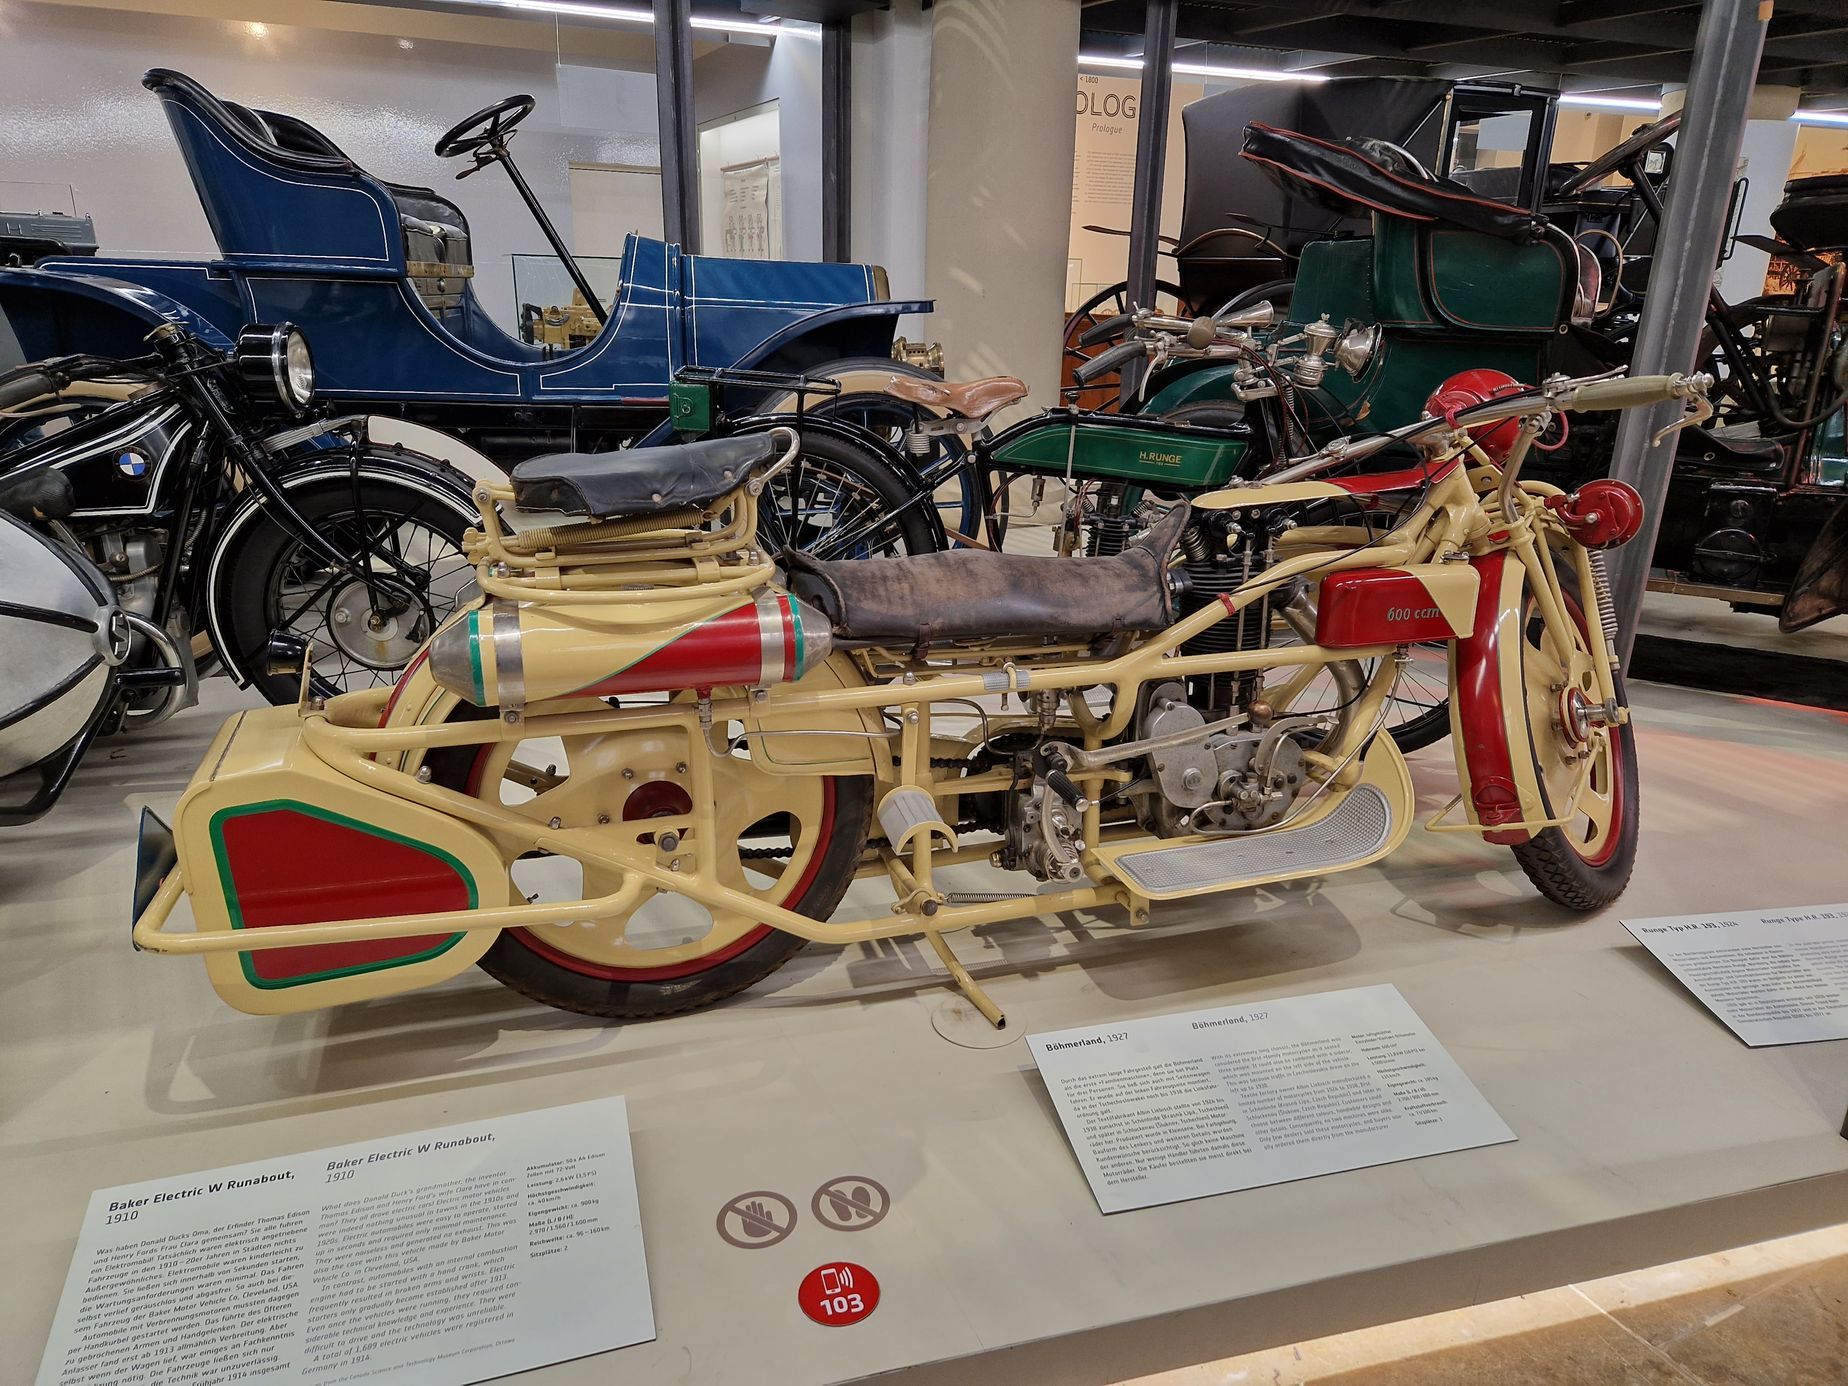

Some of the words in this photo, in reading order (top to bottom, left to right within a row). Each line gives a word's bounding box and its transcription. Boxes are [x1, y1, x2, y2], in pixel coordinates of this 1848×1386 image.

[1092, 122, 1122, 135] Prologue
[1388, 607, 1410, 621] 600
[1414, 608, 1440, 618] ccm
[1191, 1015, 1247, 1029] Böhmerland,
[1249, 1012, 1267, 1021] 1927
[1045, 1036, 1105, 1051] Böhmerland,
[1107, 1032, 1127, 1041] 1927
[326, 1158, 363, 1170] Baker
[367, 1147, 412, 1162] Electric
[417, 1143, 430, 1153] W
[434, 1133, 494, 1150] Runabout,
[108, 1198, 149, 1211] Baker
[153, 1187, 202, 1203] Electric
[208, 1182, 222, 1192] W
[226, 1170, 294, 1189] Runabout,
[326, 1169, 354, 1183] 1910
[105, 1210, 138, 1224] 1910
[115, 1243, 138, 1251] haben
[140, 1236, 166, 1246] Donald
[167, 1233, 189, 1241] Ducks
[226, 1220, 254, 1230] Erfinder
[257, 1215, 284, 1224] Thomas
[286, 1210, 309, 1218] Edison
[87, 1271, 128, 1283] Fahrzeuge
[205, 1251, 230, 1260] Jahren
[273, 1238, 296, 1246] nichts
[93, 1256, 108, 1264] und
[110, 1252, 134, 1261] Henry
[135, 1247, 157, 1256] Fords
[201, 1229, 247, 1244] gemeinsam?
[279, 1219, 302, 1228] fuhren
[309, 1293, 336, 1303] engine
[338, 1288, 354, 1297] had
[379, 1276, 407, 1288] started
[409, 1272, 427, 1281] with
[436, 1266, 456, 1275] hand
[483, 1256, 504, 1265] which
[368, 1267, 414, 1281] automobiles
[416, 1262, 433, 1270] with
[446, 1252, 475, 1264] internal
[476, 1244, 517, 1258] combustion
[95, 1285, 194, 1309] Wartungsanforderungen
[197, 1279, 222, 1288] waren
[277, 1263, 304, 1272] Fahren
[307, 1312, 337, 1323] starters
[340, 1307, 356, 1316] only
[358, 1299, 394, 1313] gradually
[395, 1293, 424, 1304] became
[426, 1282, 468, 1297] established
[469, 1278, 487, 1287] after
[308, 1299, 349, 1314] frequently
[350, 1291, 383, 1304] resulted
[394, 1284, 420, 1294] broken
[422, 1279, 442, 1288] arms
[444, 1274, 459, 1283] and
[489, 1263, 515, 1274] Electric
[820, 1294, 864, 1316] 103
[81, 1327, 127, 1341] Automobile
[146, 1306, 230, 1328] Verbrennungsmotoren
[267, 1291, 299, 1302] dagegen
[93, 1317, 130, 1329] Fahrzeug
[148, 1308, 170, 1318] Baker
[173, 1303, 196, 1312] Motor
[199, 1297, 226, 1307] Vehicle
[61, 1363, 98, 1375] Anlasser
[100, 1357, 119, 1367] fand
[121, 1354, 138, 1363] erst
[154, 1345, 174, 1356] 1913
[268, 1322, 287, 1331] Aber
[77, 1346, 130, 1363] gebrochenen
[132, 1340, 160, 1350] Armen
[162, 1335, 178, 1344] und
[256, 1311, 298, 1324] elektrische
[301, 1362, 338, 1374] Germany
